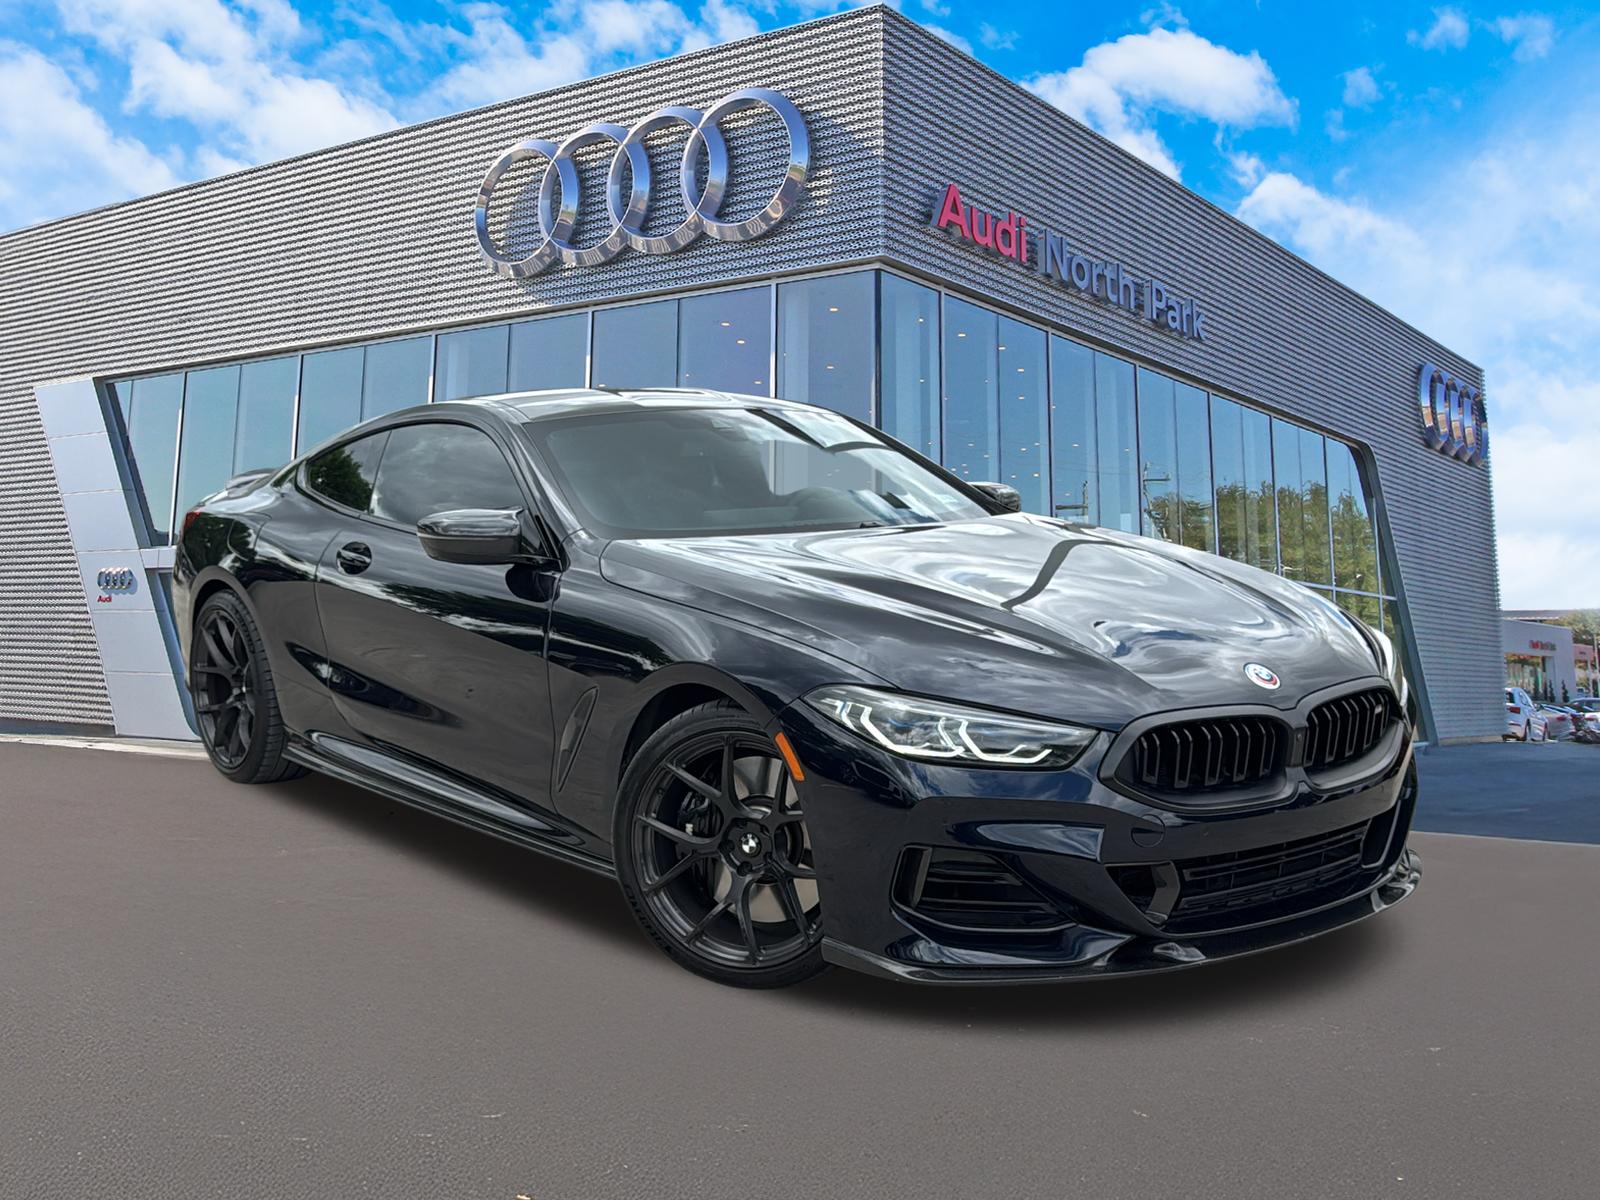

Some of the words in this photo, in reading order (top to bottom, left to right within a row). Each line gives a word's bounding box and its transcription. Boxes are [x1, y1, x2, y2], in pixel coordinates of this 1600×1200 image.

[935, 183, 1027, 264] Audi
[1043, 229, 1137, 310] North
[1149, 279, 1207, 341] Park
